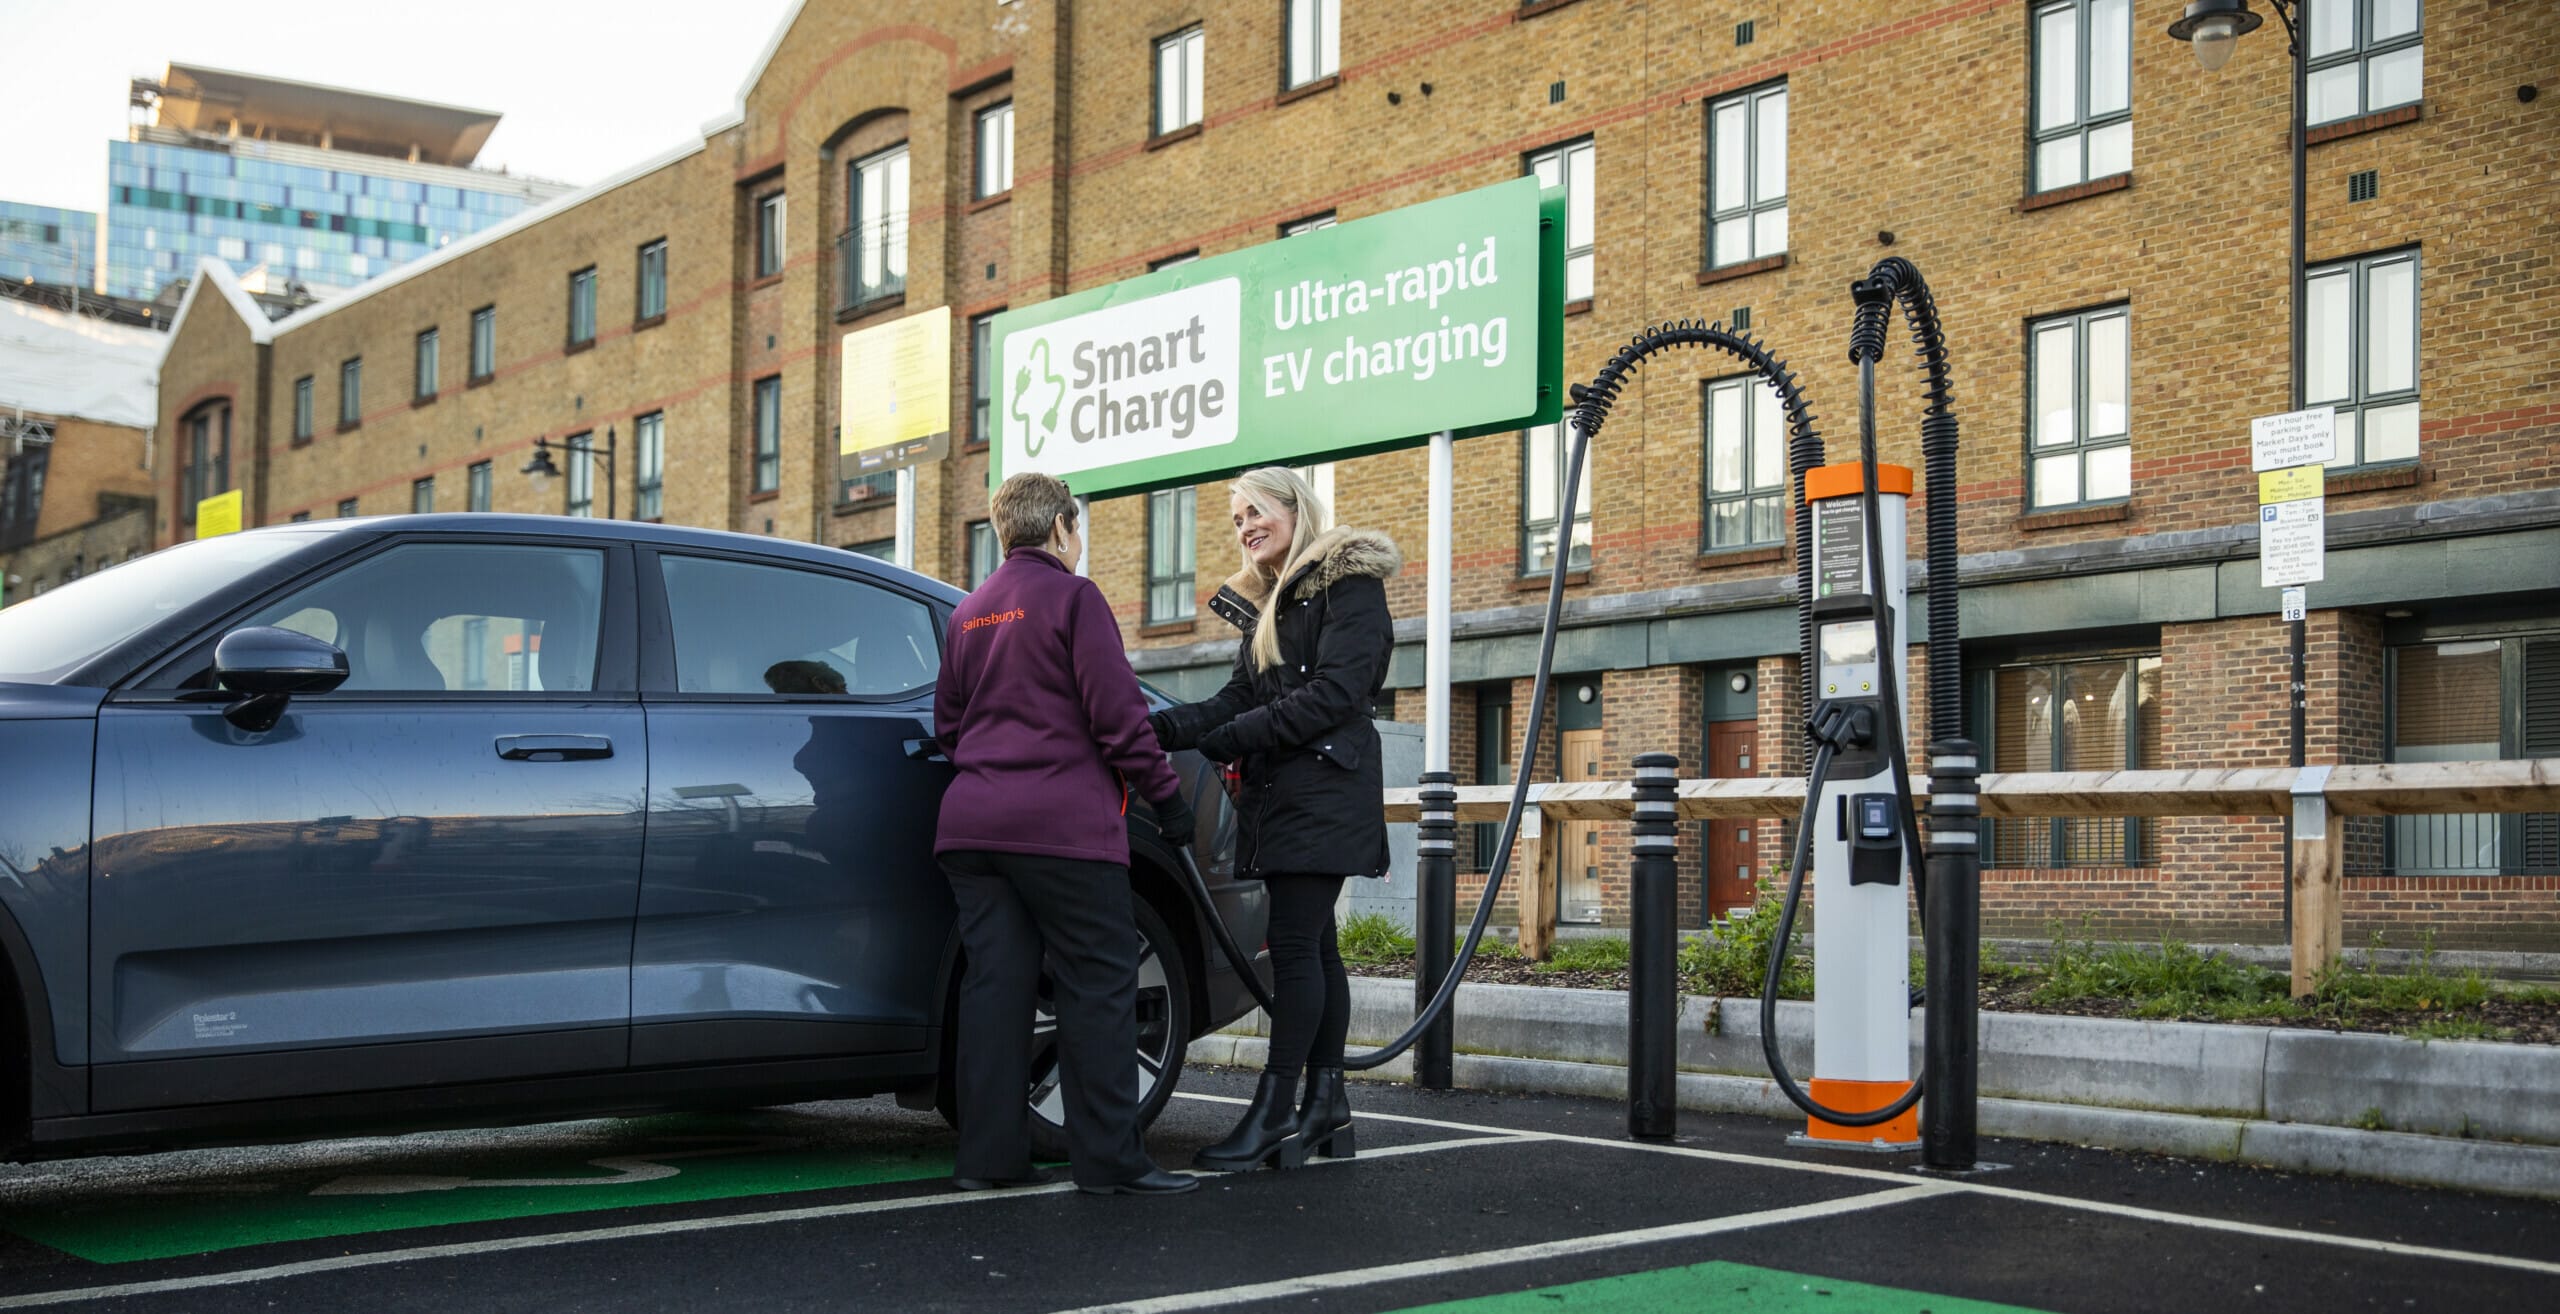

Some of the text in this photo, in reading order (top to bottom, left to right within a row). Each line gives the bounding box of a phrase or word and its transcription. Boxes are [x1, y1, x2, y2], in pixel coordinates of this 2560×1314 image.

[1273, 236, 1498, 330] Ultra-rapid
[1072, 314, 1206, 390] Smart
[1264, 316, 1508, 398] EV charging
[1070, 379, 1224, 444] Charge
[2271, 426, 2301, 436] parking
[2257, 431, 2330, 448] Market Days only
[2280, 445, 2300, 453] must
[2304, 442, 2324, 450] book
[2288, 454, 2312, 463] phone
[1826, 500, 1856, 508] Welcome
[962, 608, 1024, 634] Sainsbury's
[2287, 609, 2300, 619] 18
[194, 1012, 236, 1023] Polestar 2
